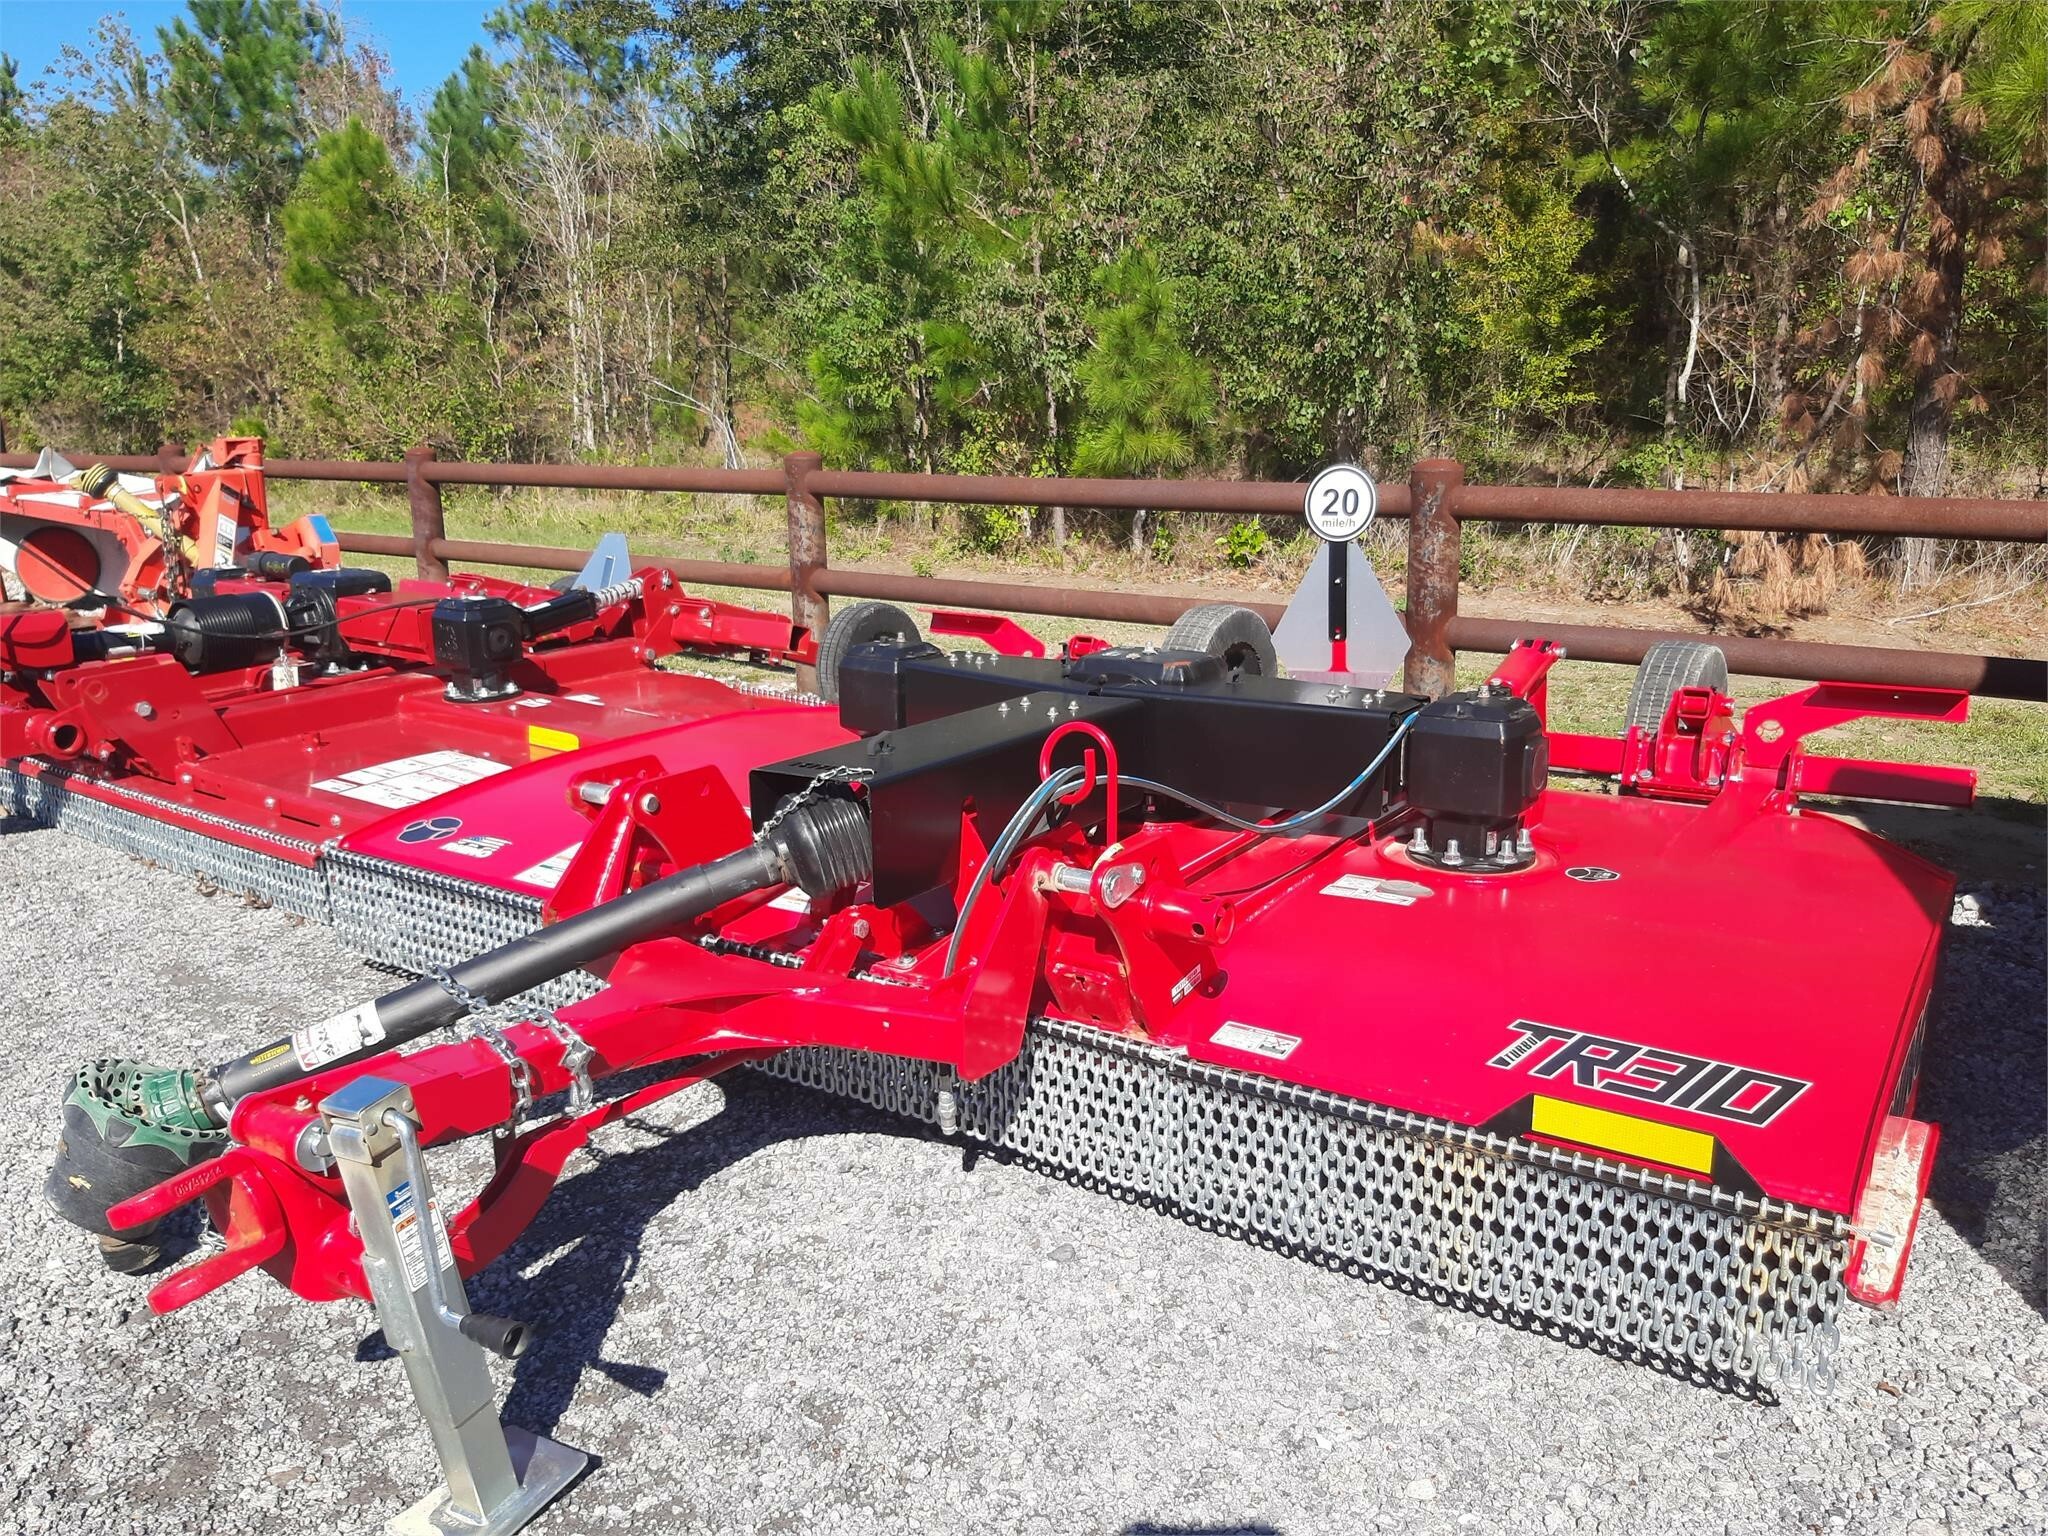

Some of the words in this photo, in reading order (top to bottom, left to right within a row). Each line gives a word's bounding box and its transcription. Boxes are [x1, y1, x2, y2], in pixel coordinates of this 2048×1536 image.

[1321, 488, 1359, 517] 20
[1322, 517, 1356, 528] mile/h
[1503, 1035, 1539, 1062] TURBO
[1485, 1018, 1814, 1128] TR310
